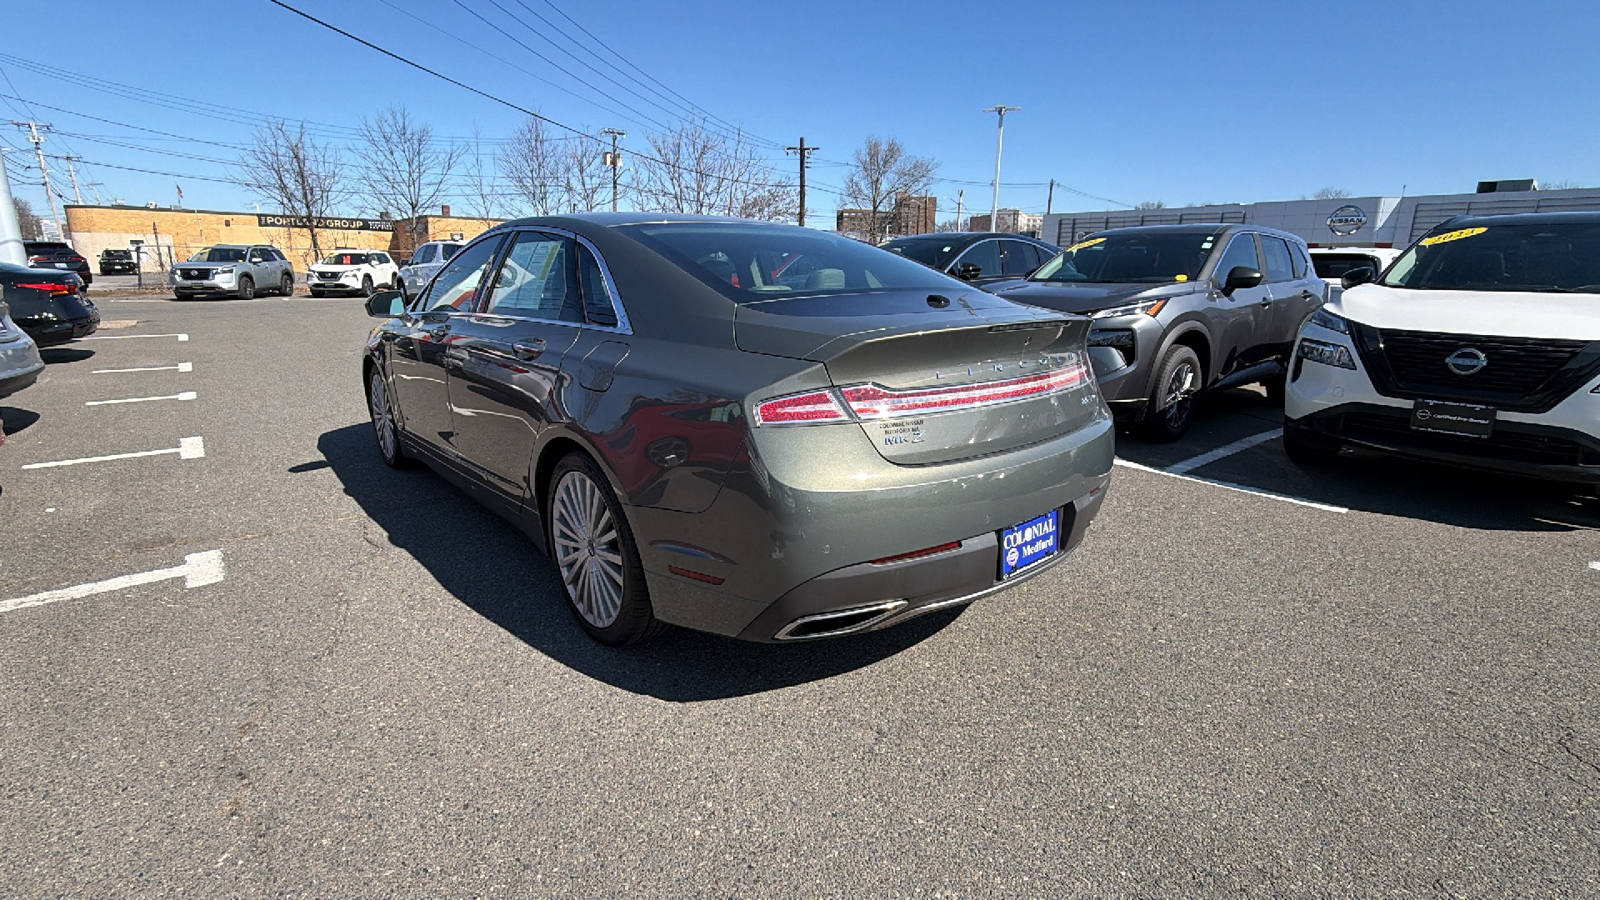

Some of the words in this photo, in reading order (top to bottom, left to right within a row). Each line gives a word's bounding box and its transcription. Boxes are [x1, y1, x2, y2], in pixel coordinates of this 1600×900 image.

[326, 219, 364, 228] GROUP
[936, 353, 1074, 380] LINCOLN
[879, 421, 905, 429] COLONIAL
[1003, 518, 1056, 549] COLONIAL
[1022, 535, 1053, 558] Medford
